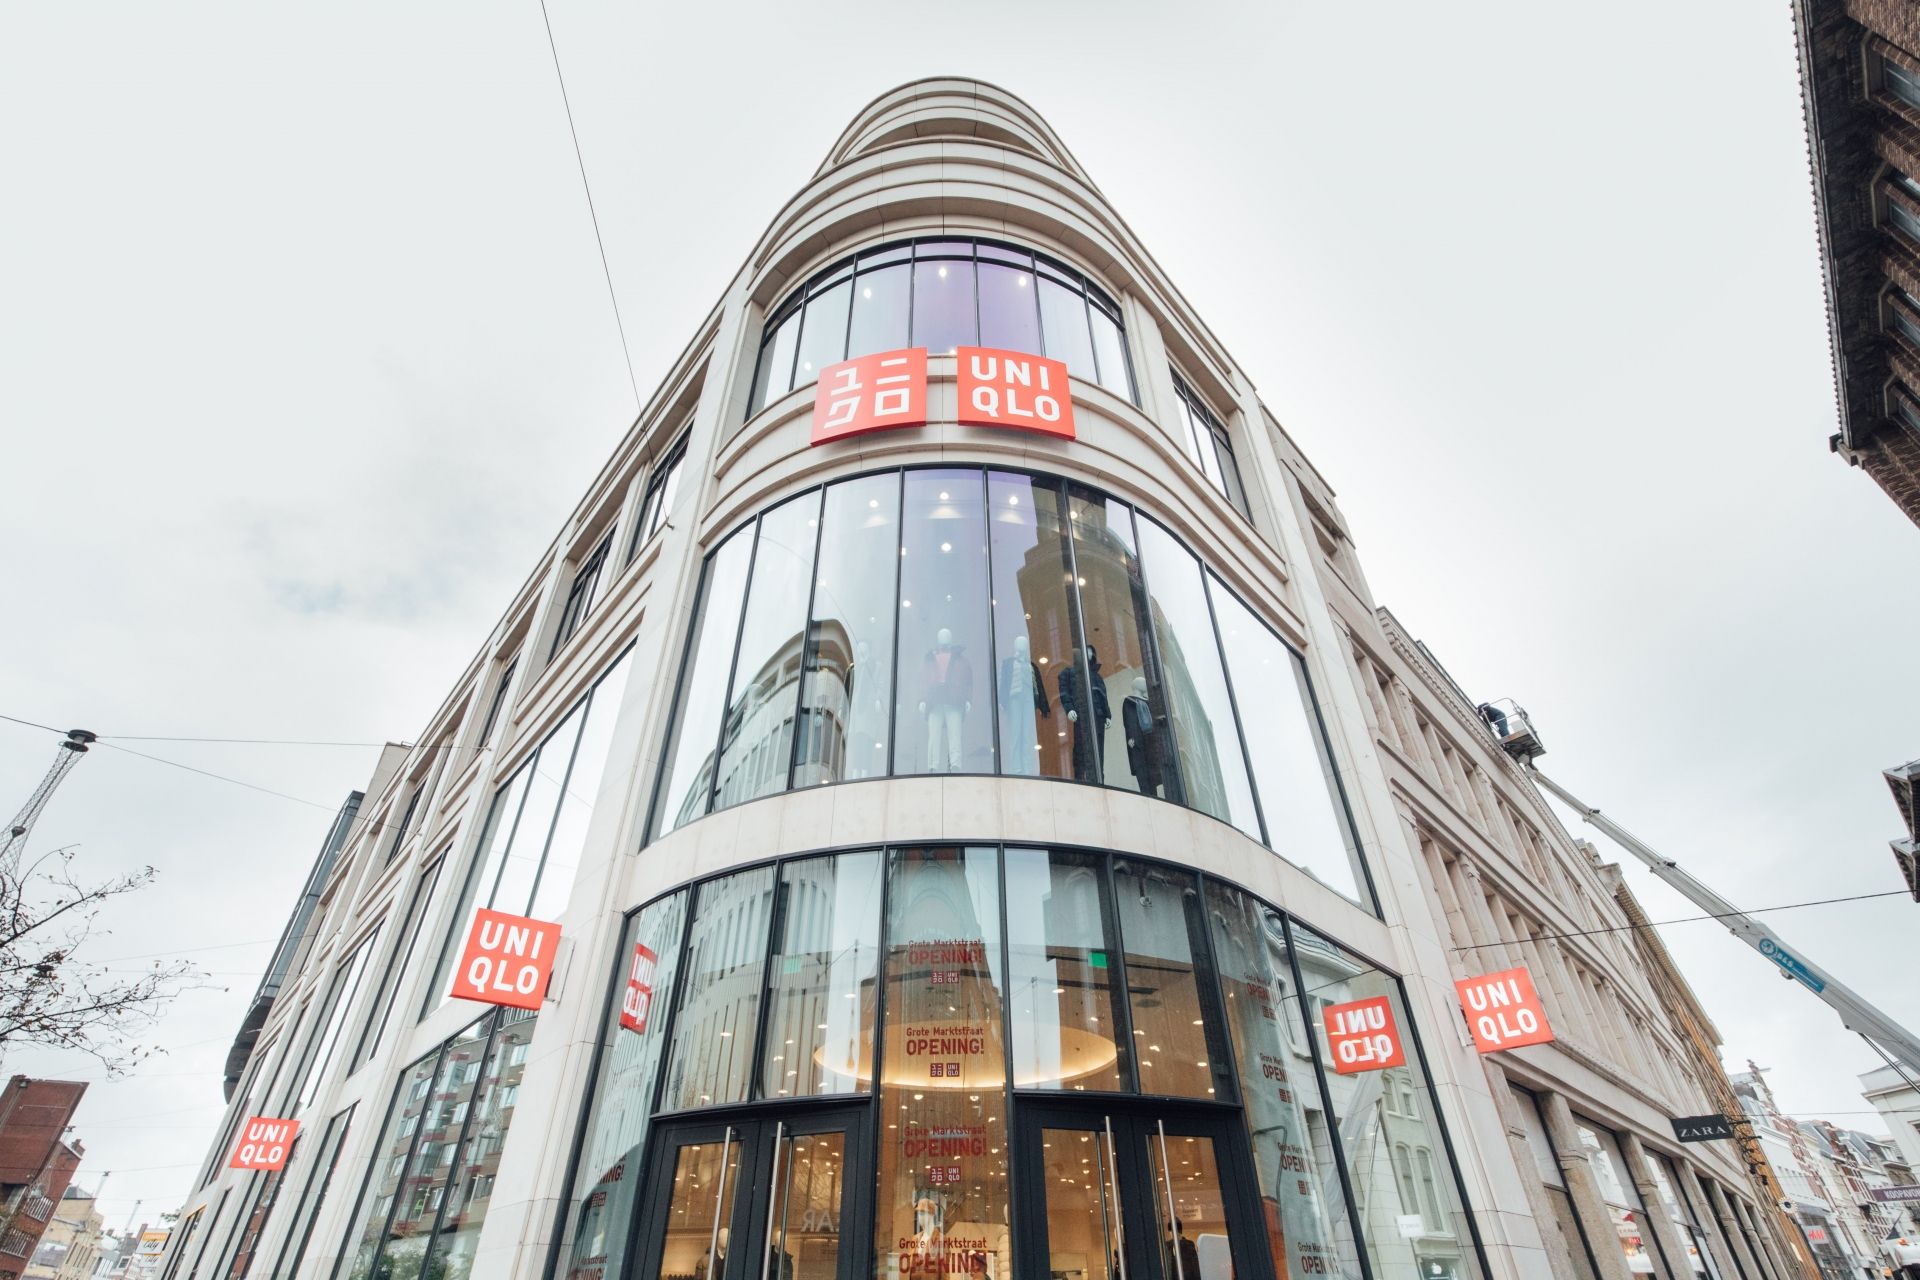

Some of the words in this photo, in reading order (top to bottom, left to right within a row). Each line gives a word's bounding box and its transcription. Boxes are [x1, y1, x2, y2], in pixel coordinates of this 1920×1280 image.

[971, 355, 1050, 391] UNI
[971, 386, 1061, 422] QLO
[479, 920, 544, 960] UNI
[908, 948, 983, 965] OPENING!
[467, 956, 539, 995] QLO
[1465, 979, 1524, 1012] UNI
[906, 1027, 930, 1036] Grote
[933, 1026, 984, 1036] Marktstraat
[1477, 1008, 1538, 1044] QLO
[906, 1038, 985, 1056] OPENING!
[248, 1123, 290, 1142] UNI
[932, 1124, 987, 1136] Marktstraat
[1680, 1124, 1728, 1139] ZARA
[239, 1144, 284, 1166] QLO
[903, 1138, 987, 1158] OPENING!
[930, 1236, 987, 1249] Marktstraat
